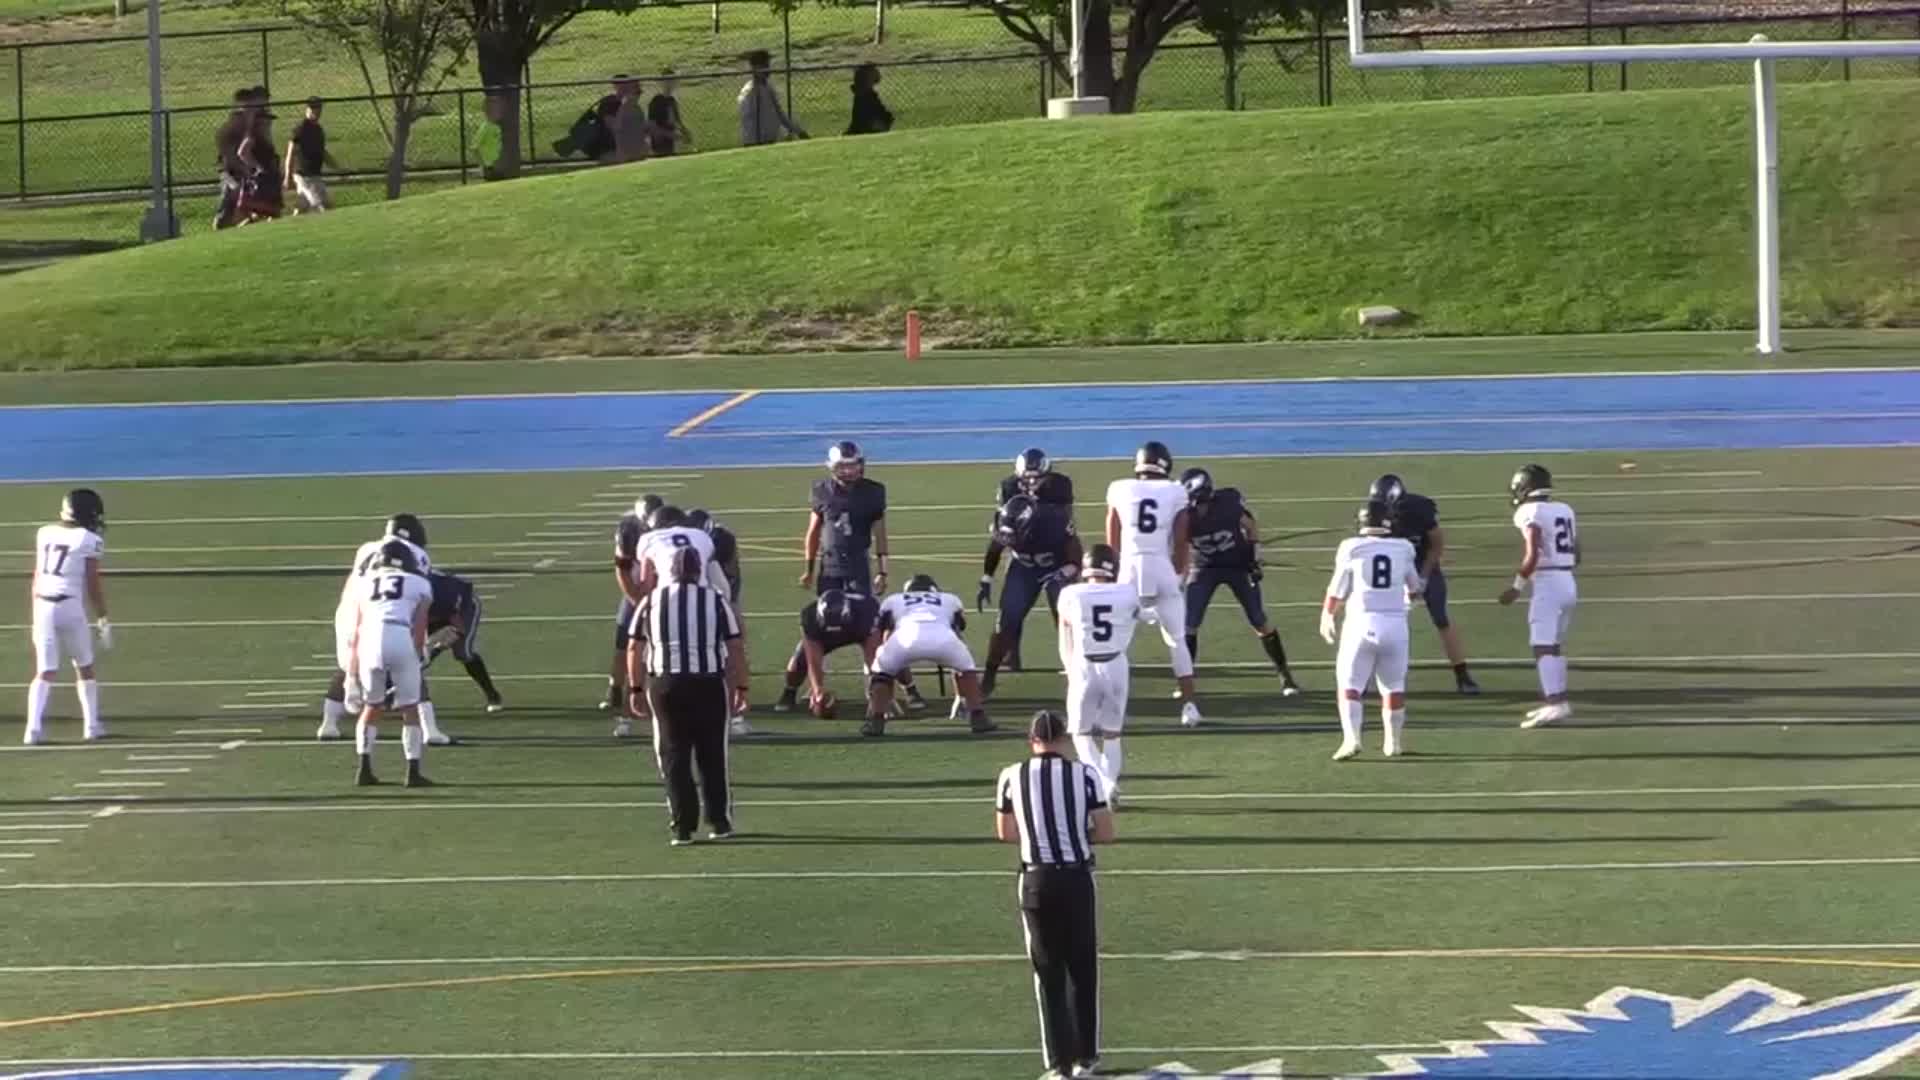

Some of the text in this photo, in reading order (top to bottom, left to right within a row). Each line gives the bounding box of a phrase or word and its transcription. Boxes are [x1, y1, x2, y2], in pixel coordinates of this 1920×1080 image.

[1138, 498, 1158, 533] 6
[1554, 517, 1575, 554] 21
[43, 543, 70, 577] 17
[1372, 554, 1392, 589] 8
[370, 575, 405, 601] 13
[1092, 604, 1112, 642] 5
